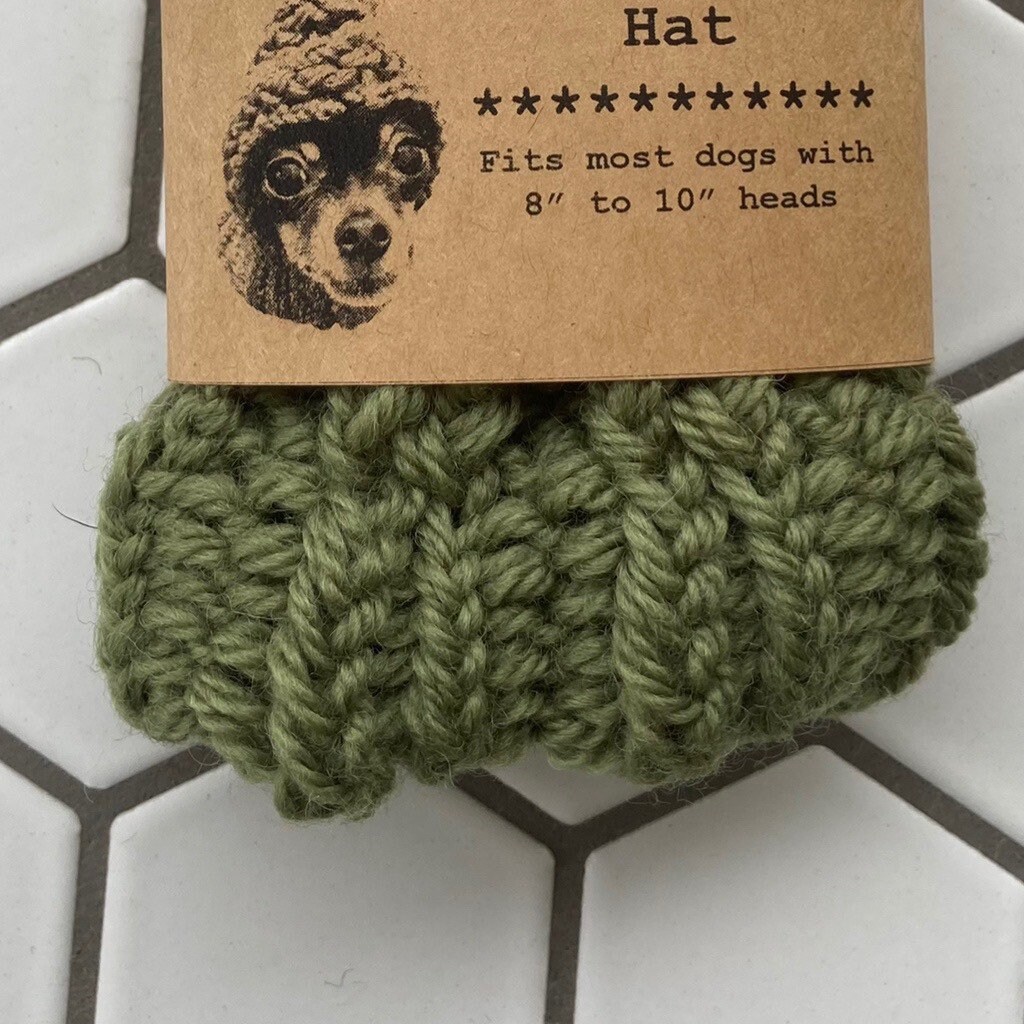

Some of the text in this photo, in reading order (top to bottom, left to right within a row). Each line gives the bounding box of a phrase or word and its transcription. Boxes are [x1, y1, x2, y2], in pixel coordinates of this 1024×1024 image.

[623, 5, 737, 47] Hat
[479, 139, 875, 173] Fits most dogs with
[590, 190, 632, 214] to
[737, 183, 838, 210] heads
